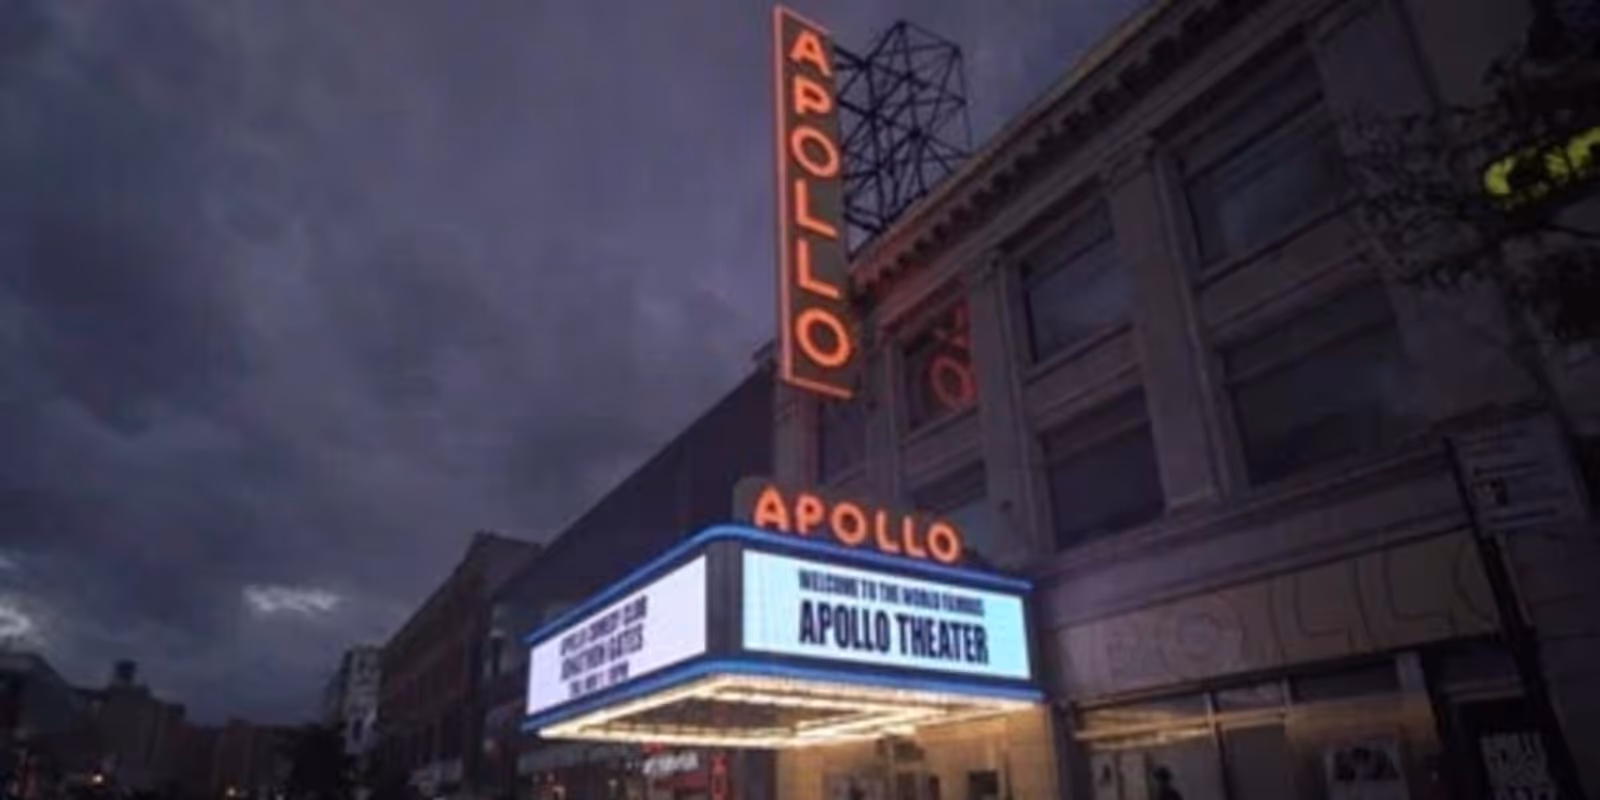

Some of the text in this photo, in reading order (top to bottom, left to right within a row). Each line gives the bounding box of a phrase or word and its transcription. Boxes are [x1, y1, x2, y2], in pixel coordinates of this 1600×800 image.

[790, 30, 850, 368] APOLLO
[753, 484, 963, 564] APOLLO
[879, 581, 899, 605] THE
[799, 599, 990, 665] APOLLO THEATER
